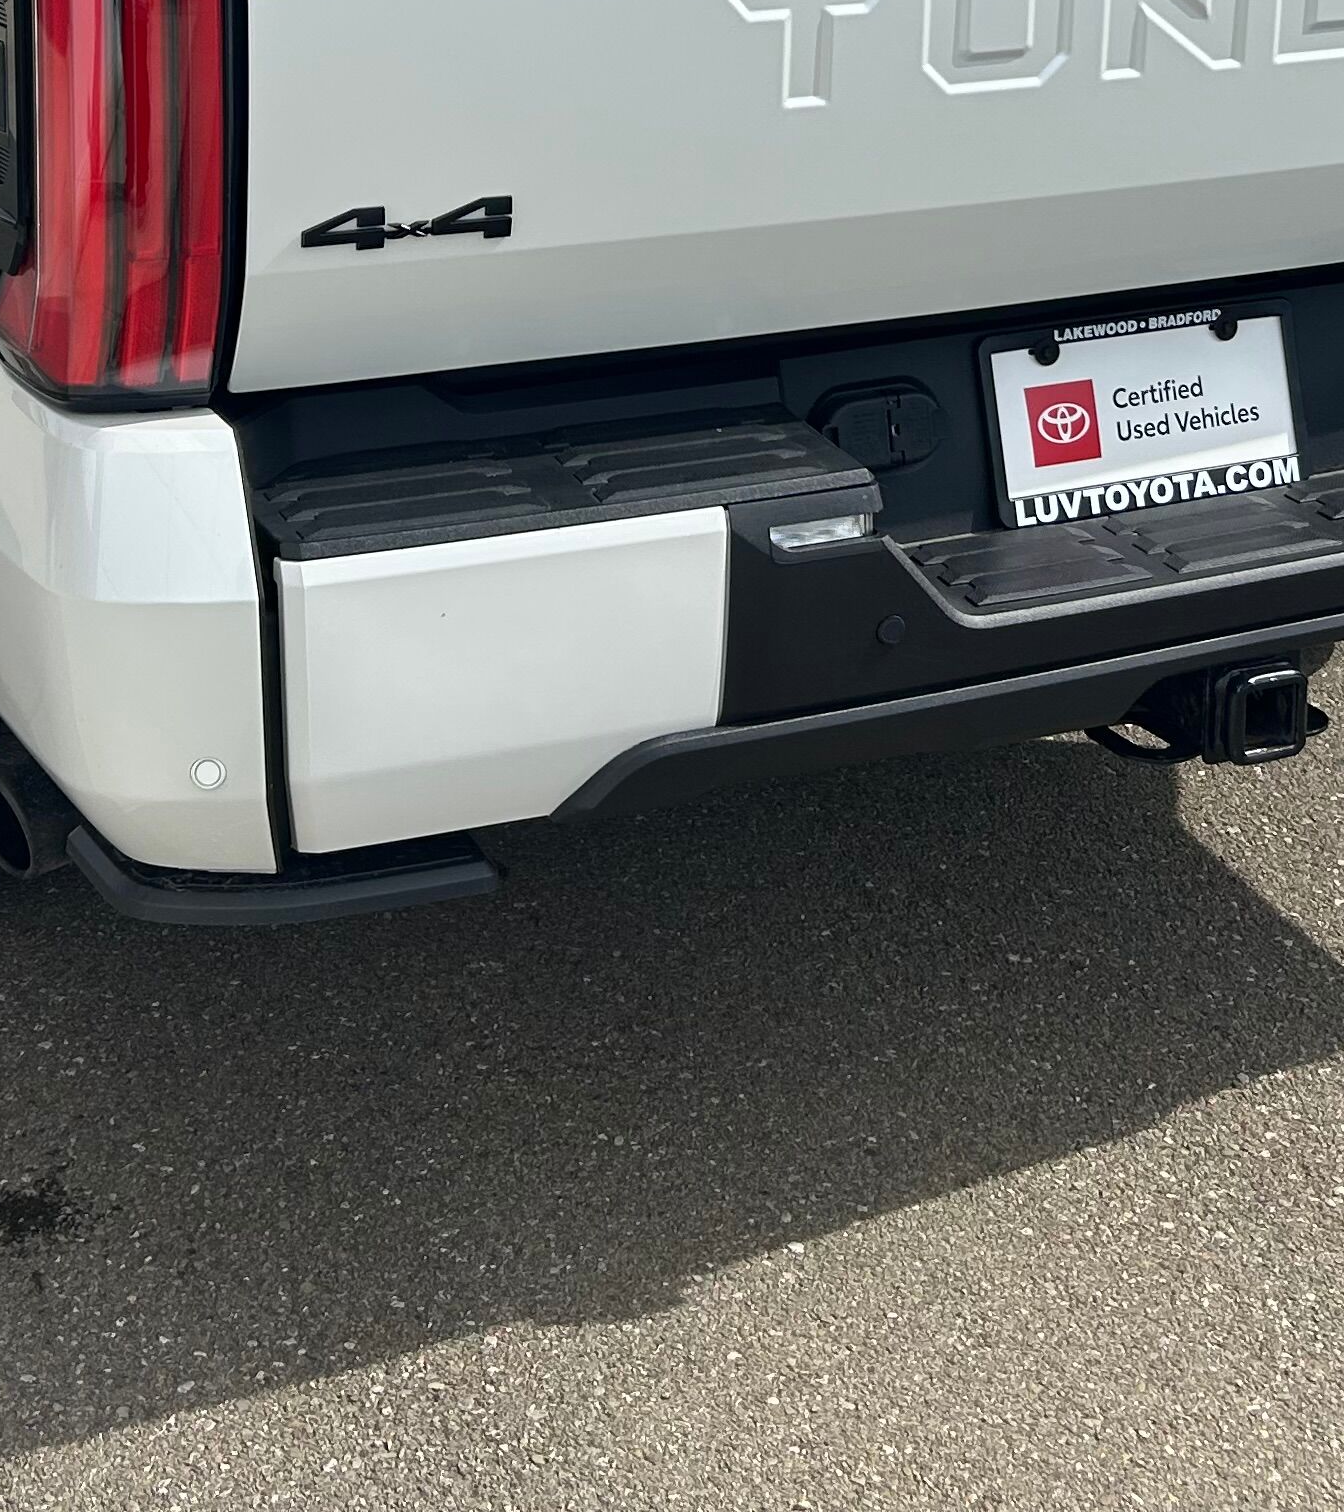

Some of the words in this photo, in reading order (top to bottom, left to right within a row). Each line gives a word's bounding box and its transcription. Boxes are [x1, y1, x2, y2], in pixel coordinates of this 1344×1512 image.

[301, 194, 513, 250] 4x4
[1053, 319, 1138, 342] LAKEWOOD
[1148, 308, 1222, 330] BRADFORD
[1112, 375, 1204, 408] Certified
[1116, 413, 1171, 442] Used
[1174, 402, 1261, 432] Vehicles
[1014, 456, 1302, 528] LUVTOYOTA.COM
